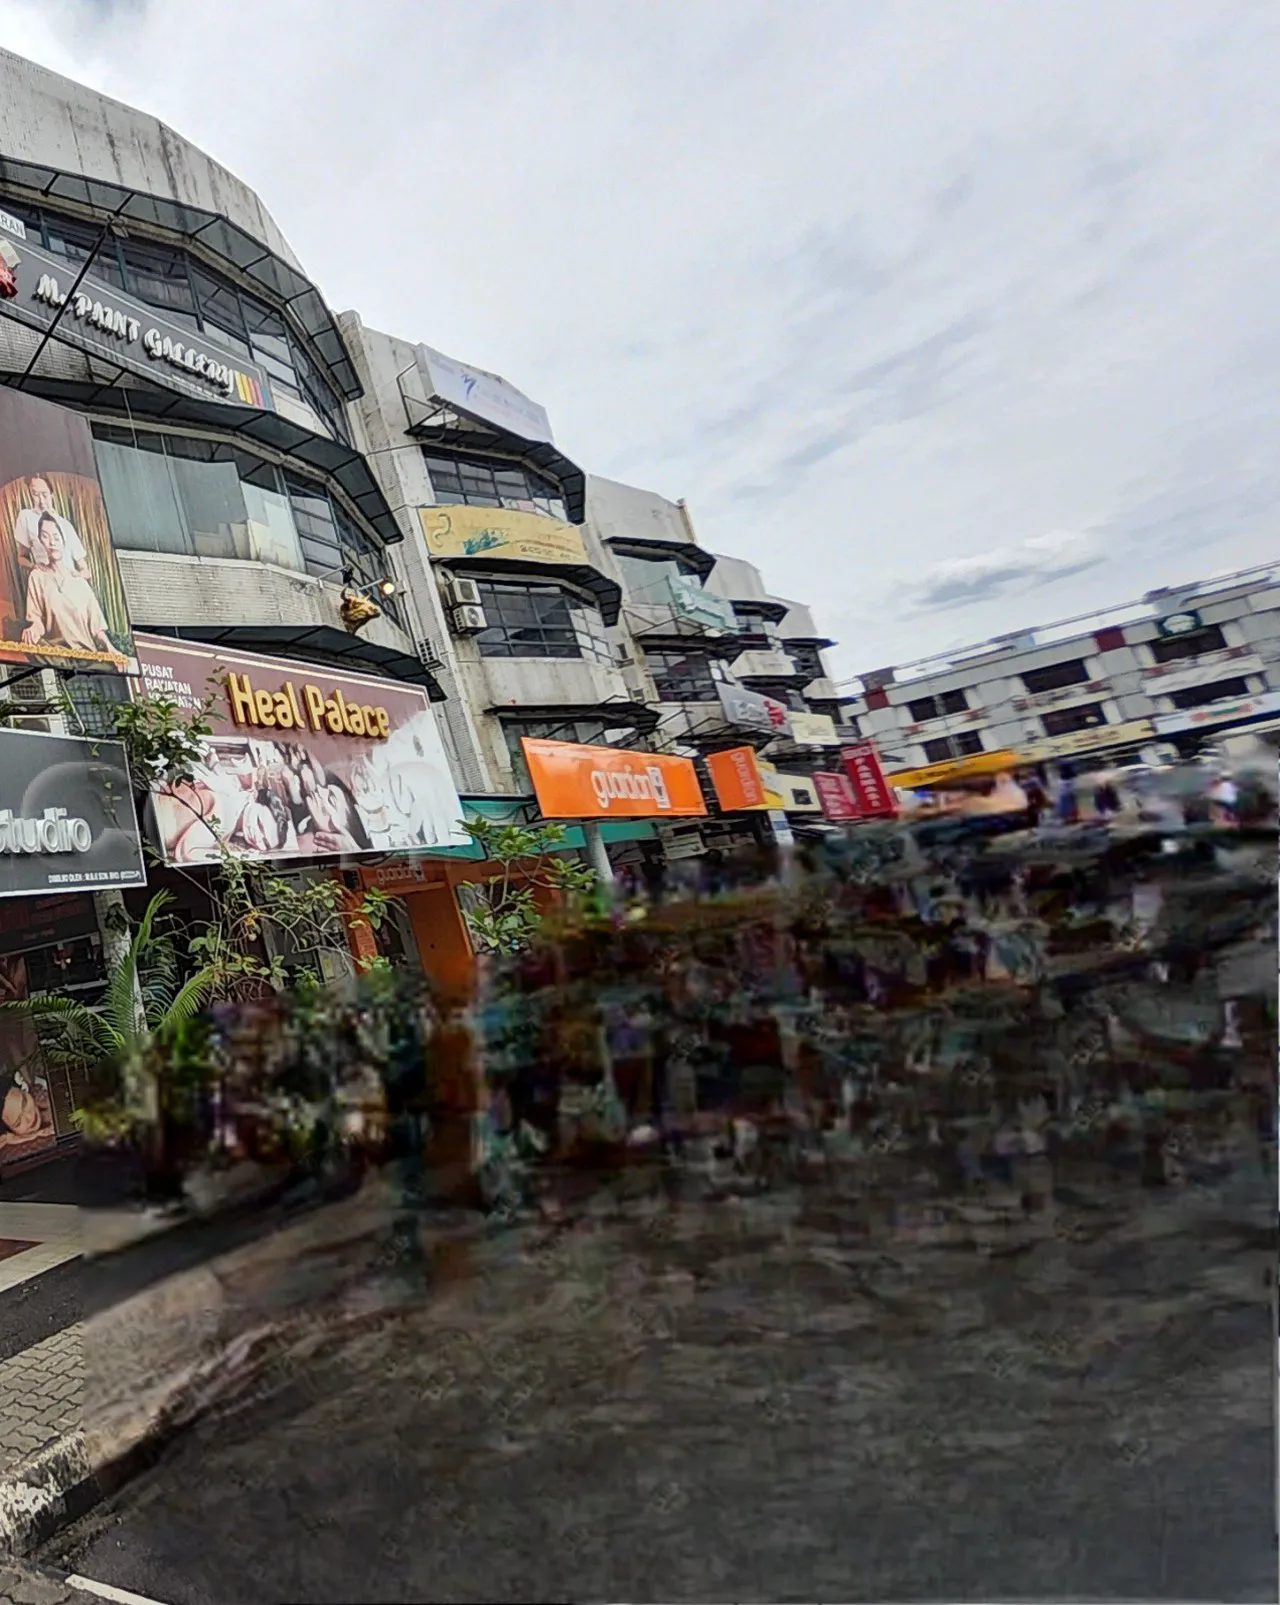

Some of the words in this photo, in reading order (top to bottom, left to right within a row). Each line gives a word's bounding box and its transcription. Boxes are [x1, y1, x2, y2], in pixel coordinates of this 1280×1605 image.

[141, 662, 174, 679] PUSAT
[227, 672, 305, 731] Heal
[304, 683, 392, 739] Palace
